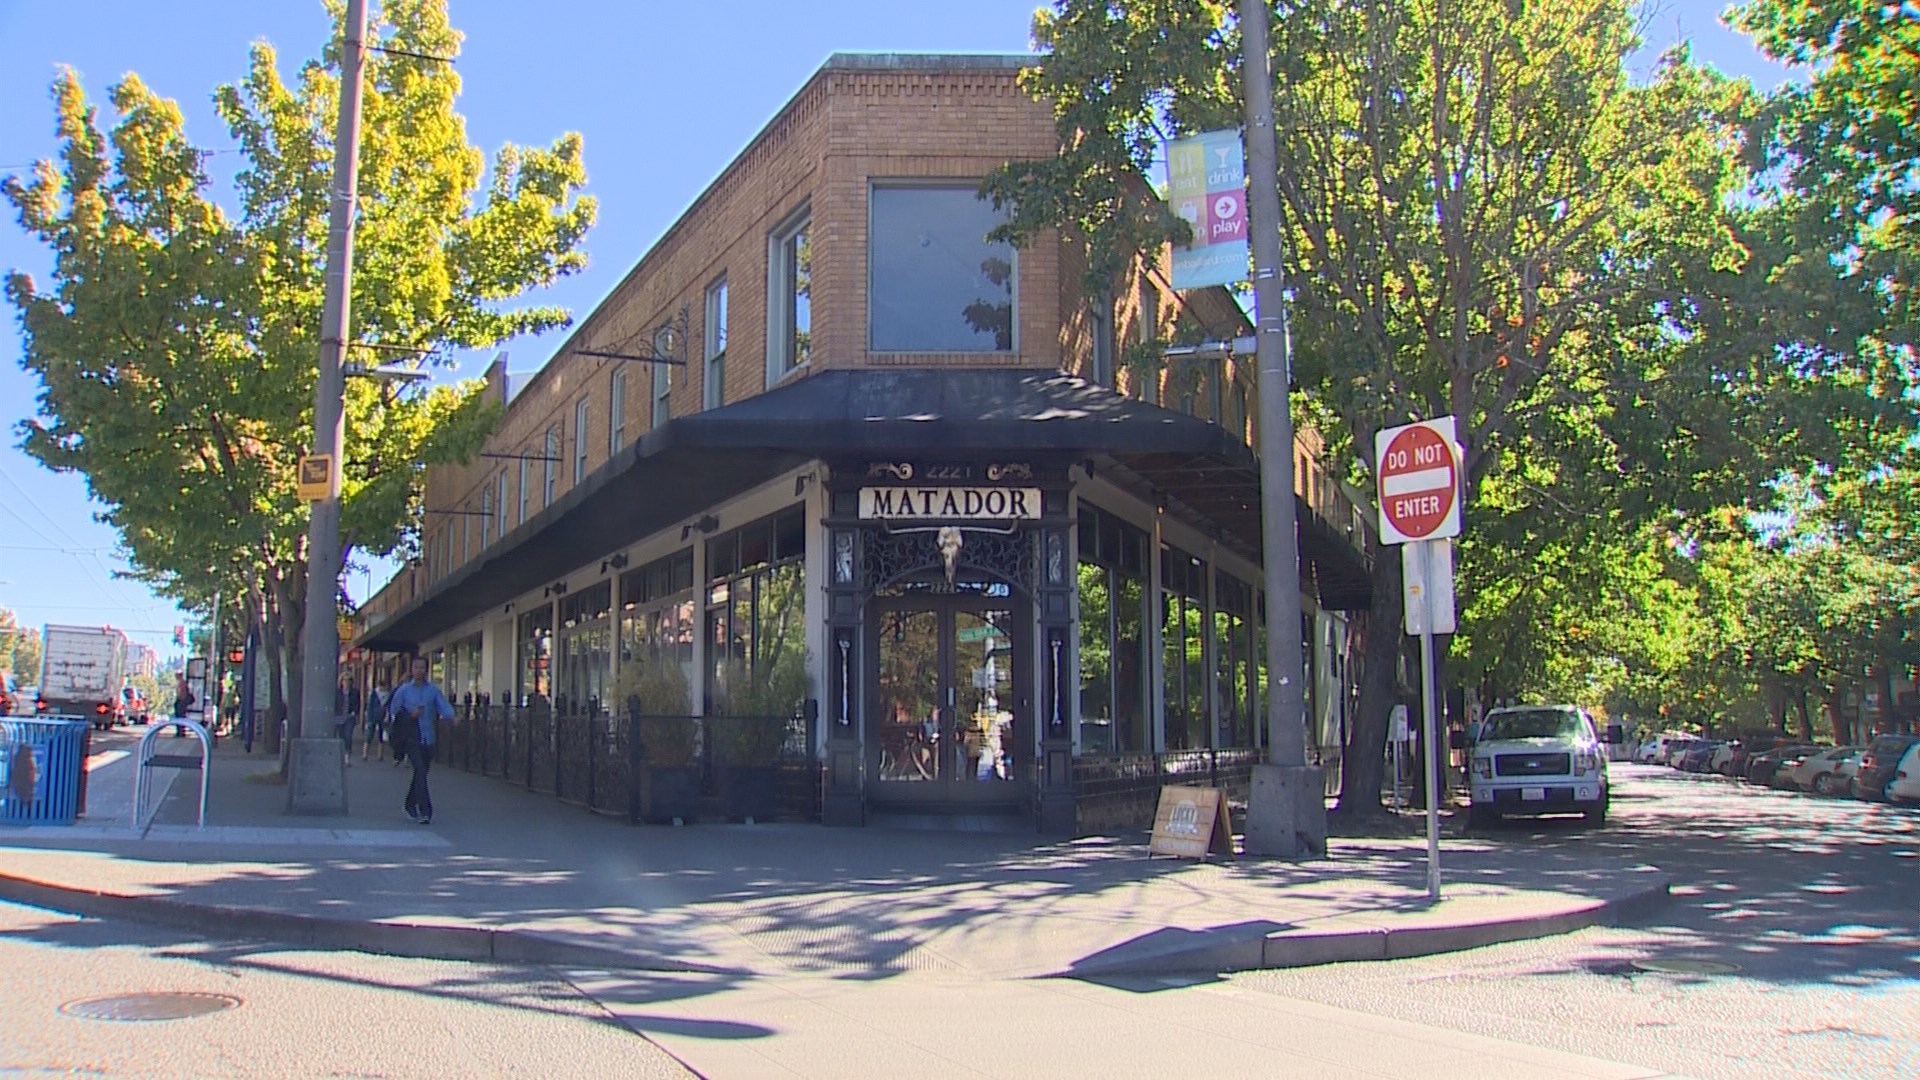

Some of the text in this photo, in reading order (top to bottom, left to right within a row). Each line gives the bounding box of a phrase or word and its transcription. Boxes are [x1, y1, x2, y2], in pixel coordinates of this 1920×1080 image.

[1175, 176, 1198, 189] eat
[1208, 168, 1241, 186] drink
[1212, 219, 1242, 238] play
[1388, 443, 1443, 470] DO NOT
[926, 465, 971, 479] 2221
[872, 489, 1028, 516] MATADOR
[1395, 495, 1440, 519] ENTER
